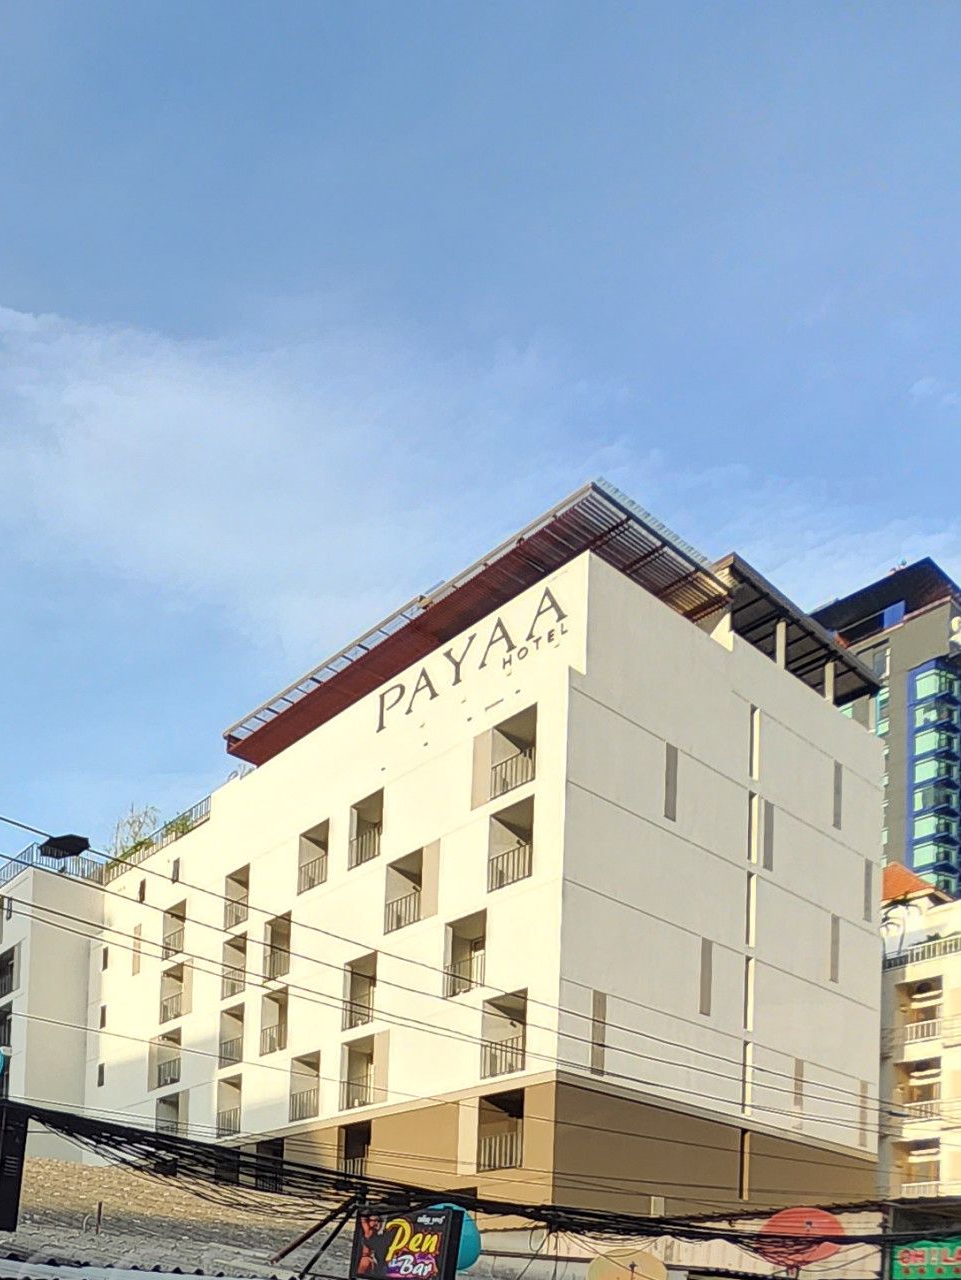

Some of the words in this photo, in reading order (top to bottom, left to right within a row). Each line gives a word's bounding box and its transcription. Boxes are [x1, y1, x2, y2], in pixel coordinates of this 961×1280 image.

[376, 586, 568, 734] PAYAA
[501, 622, 568, 670] HOTEL
[385, 1217, 438, 1262] Pen
[398, 1254, 433, 1277] Bar
